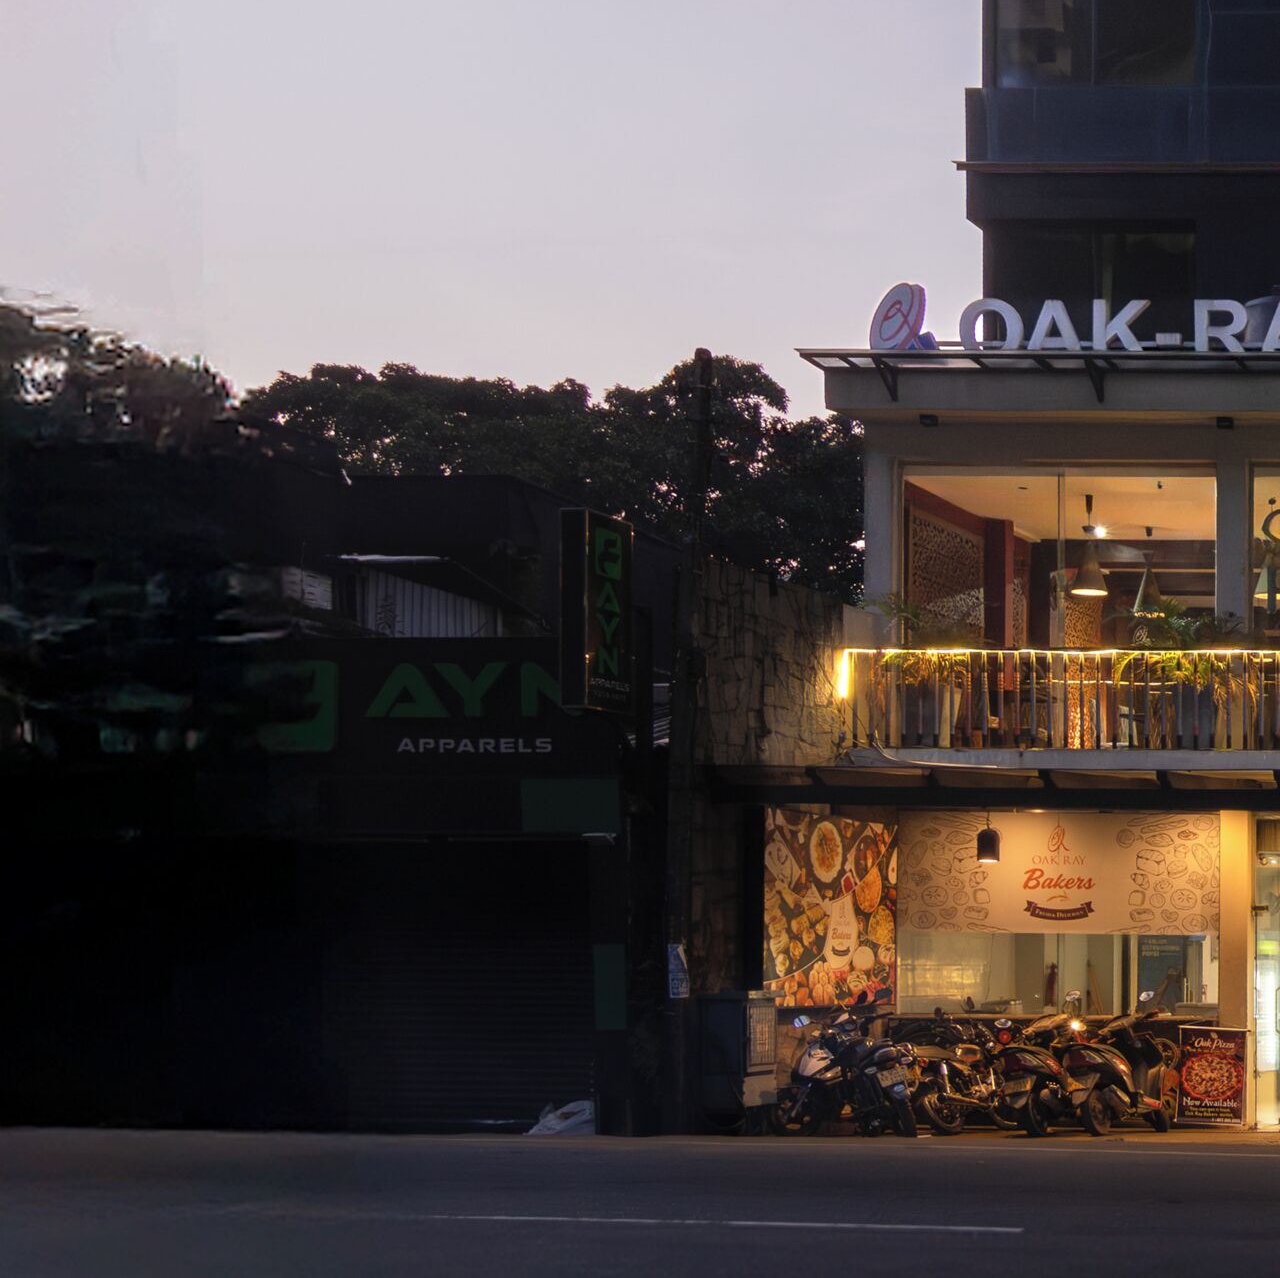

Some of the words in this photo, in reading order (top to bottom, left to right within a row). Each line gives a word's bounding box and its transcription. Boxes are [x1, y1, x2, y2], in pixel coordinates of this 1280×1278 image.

[590, 677, 631, 692] APPARELS
[397, 738, 552, 753] APPARELS
[1032, 855, 1058, 865] OAK
[1063, 855, 1087, 865] RAY
[1023, 868, 1096, 890] Bakers
[1194, 1037, 1211, 1048] Oak
[1212, 1038, 1235, 1050] Pizza
[1183, 1096, 1201, 1106] Now
[1202, 1098, 1237, 1108] Available
